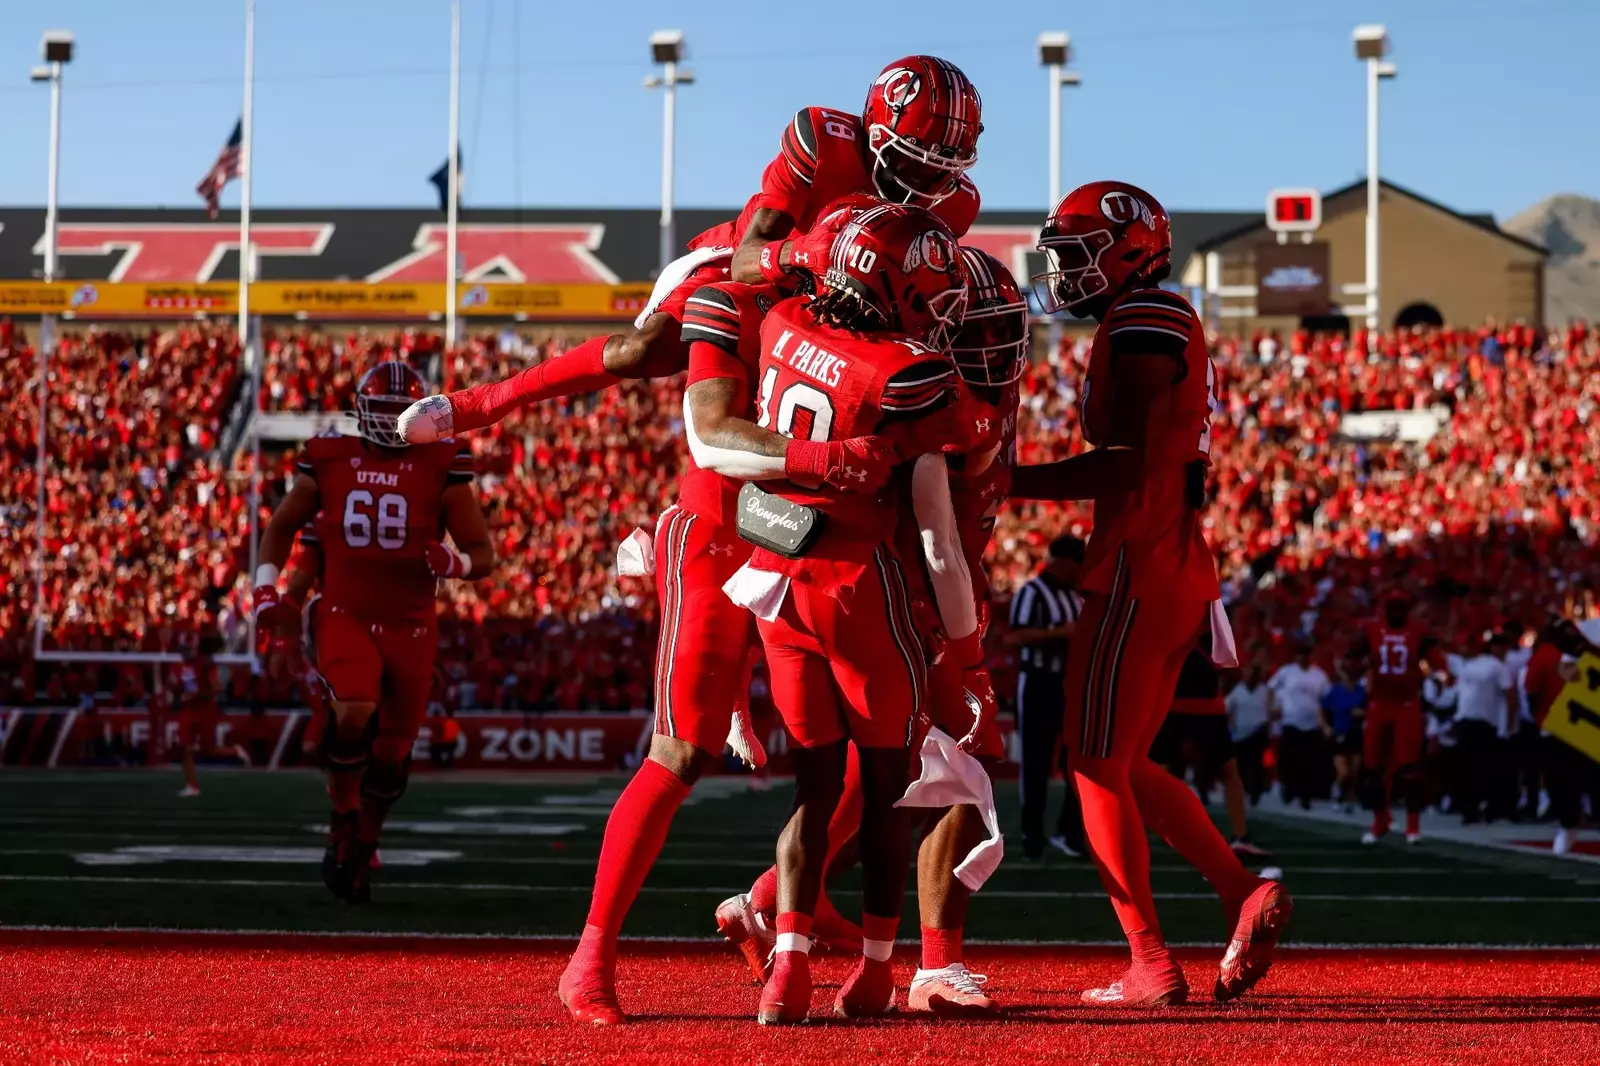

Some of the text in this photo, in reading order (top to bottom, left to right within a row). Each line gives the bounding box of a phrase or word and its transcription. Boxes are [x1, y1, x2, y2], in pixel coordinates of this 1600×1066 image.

[849, 245, 877, 274] 10
[788, 339, 847, 388] PARKS
[757, 365, 836, 446] 10
[356, 470, 399, 487] UTAH
[343, 489, 409, 551] 68
[745, 496, 799, 531] Douglas
[1377, 643, 1410, 676] 13
[479, 727, 606, 761] ZONE
